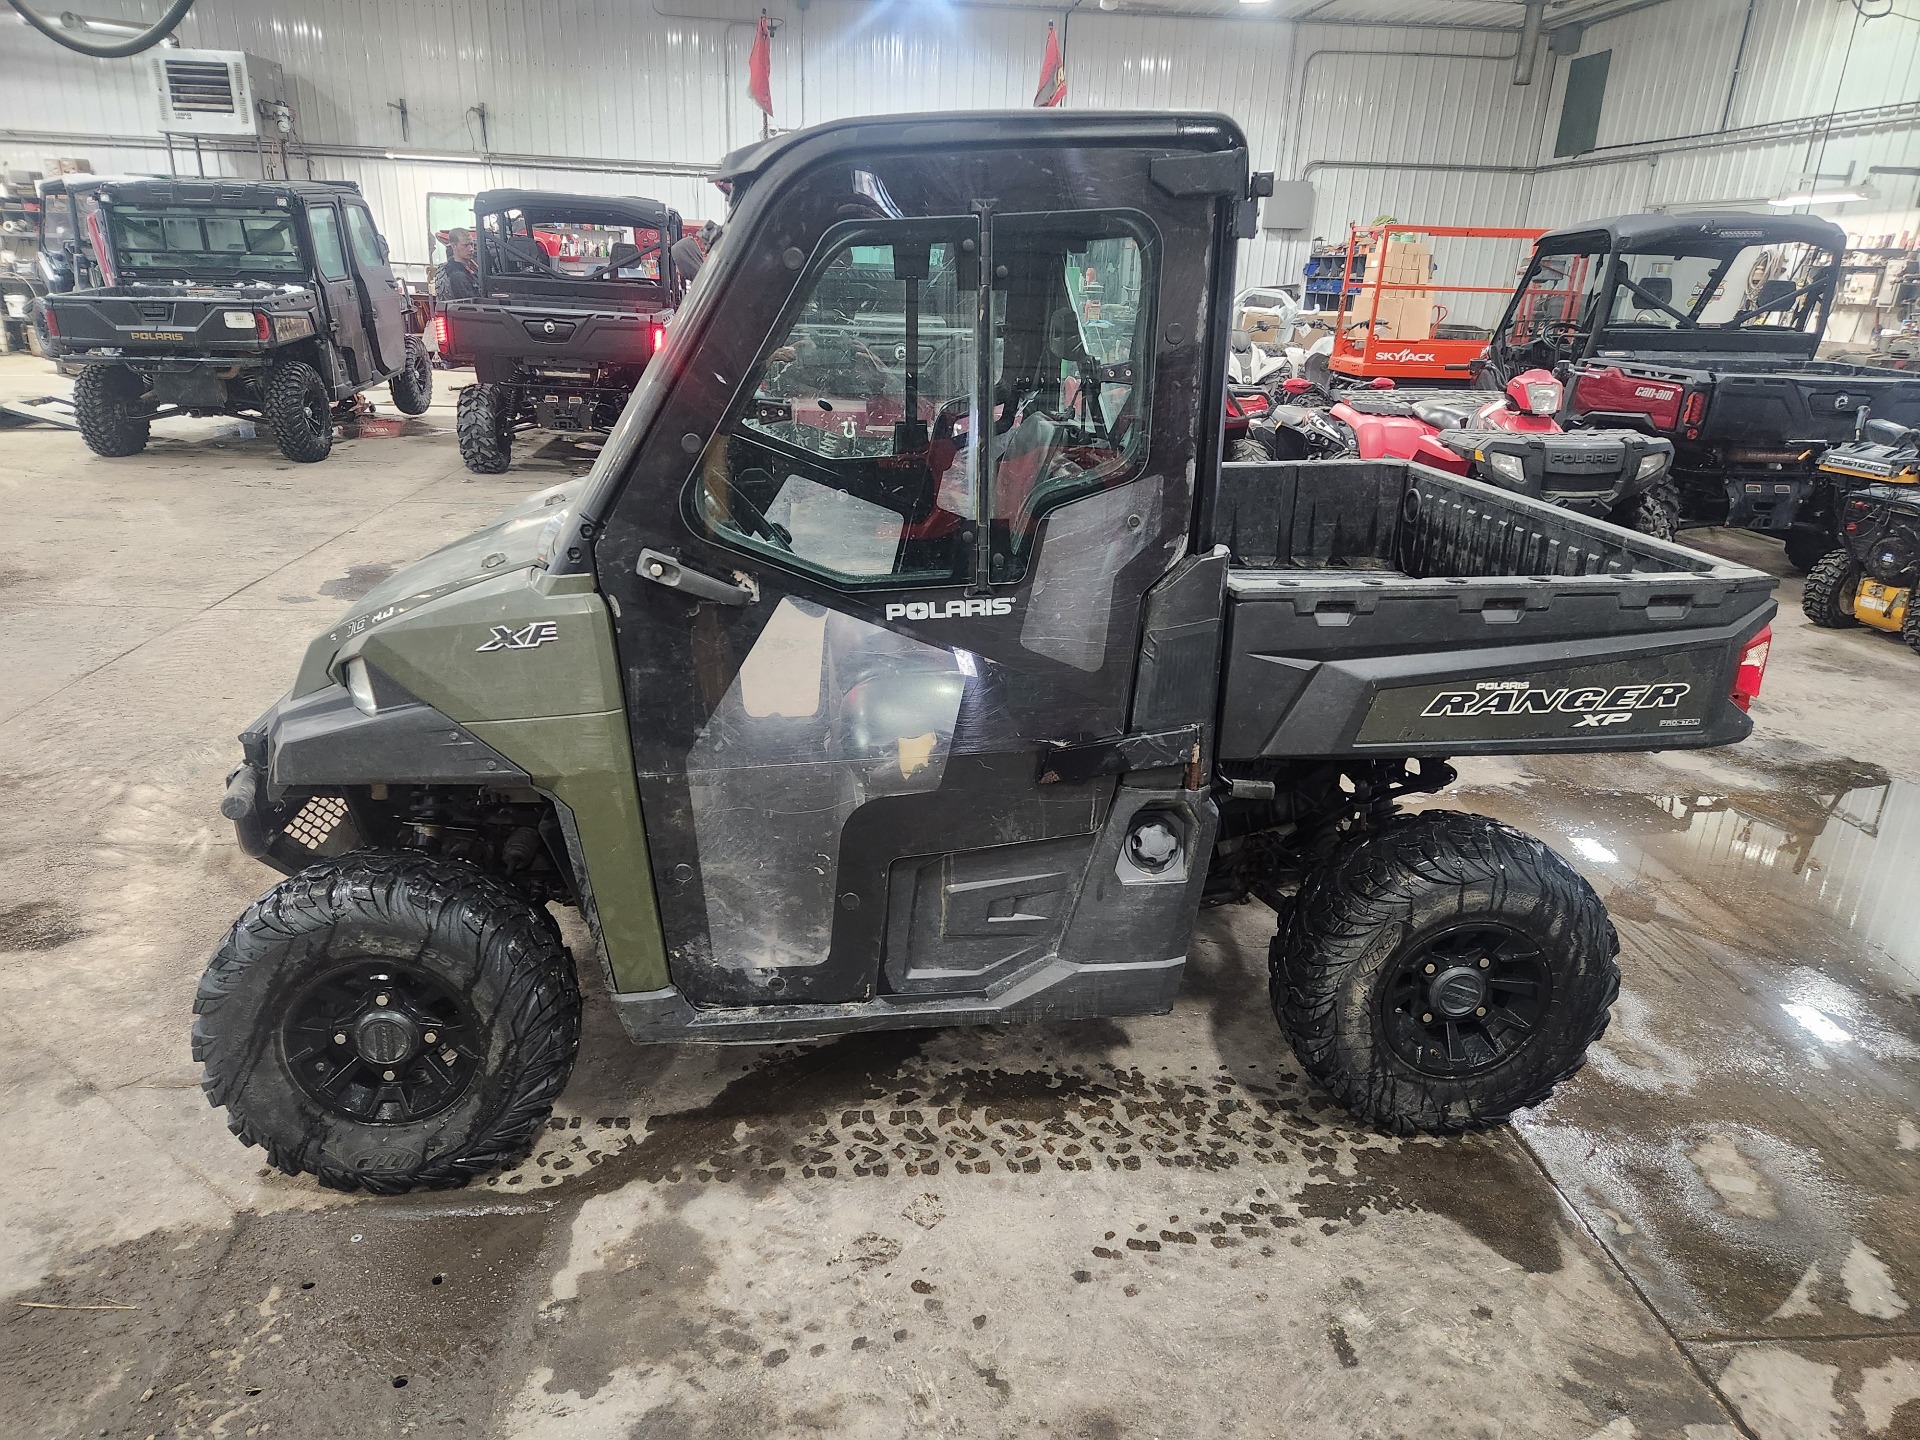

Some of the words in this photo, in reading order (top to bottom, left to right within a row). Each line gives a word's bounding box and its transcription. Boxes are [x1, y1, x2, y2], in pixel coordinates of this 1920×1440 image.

[130, 332, 183, 341] POLARIS
[1375, 348, 1435, 362] SKYJACK
[1551, 452, 1618, 464] POLARIS
[885, 598, 1012, 621] POLARIS
[1475, 681, 1530, 690] POLARIS
[1420, 683, 1690, 716] RANGER
[1569, 712, 1633, 728] XP
